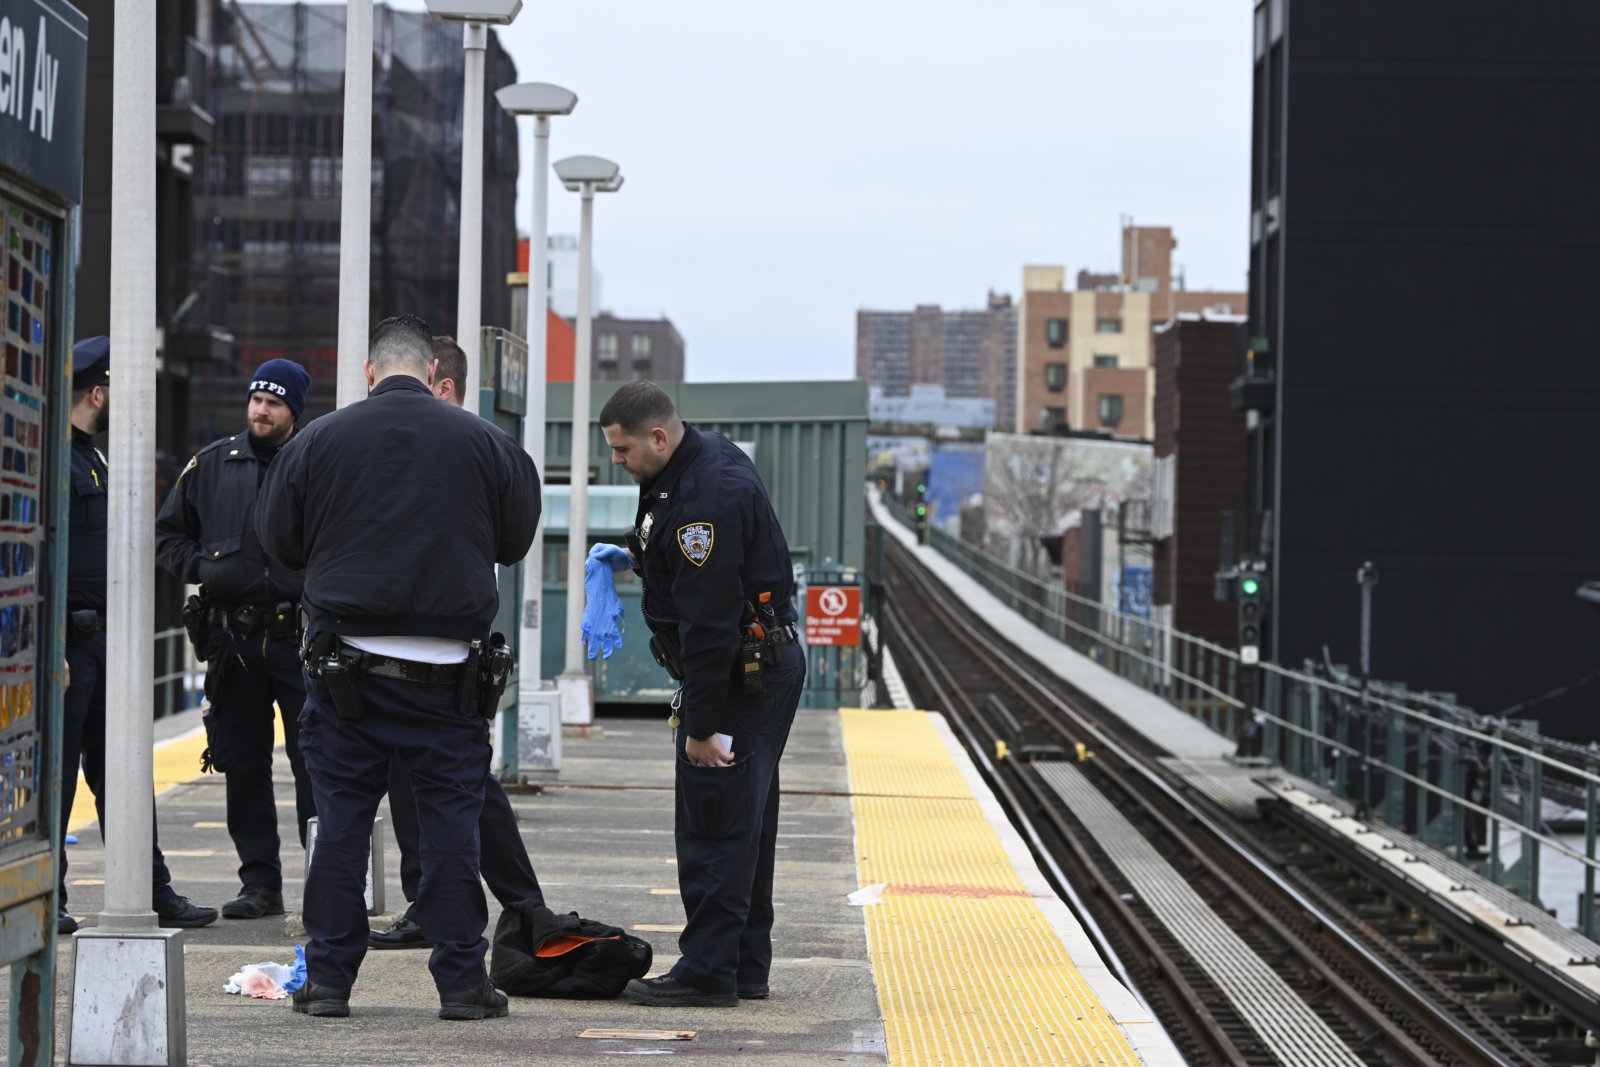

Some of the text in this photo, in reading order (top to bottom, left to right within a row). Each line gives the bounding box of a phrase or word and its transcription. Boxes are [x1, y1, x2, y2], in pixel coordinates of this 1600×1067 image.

[29, 15, 59, 142] Av
[249, 380, 286, 396] NYPD
[681, 530, 710, 540] DEPARTMENT
